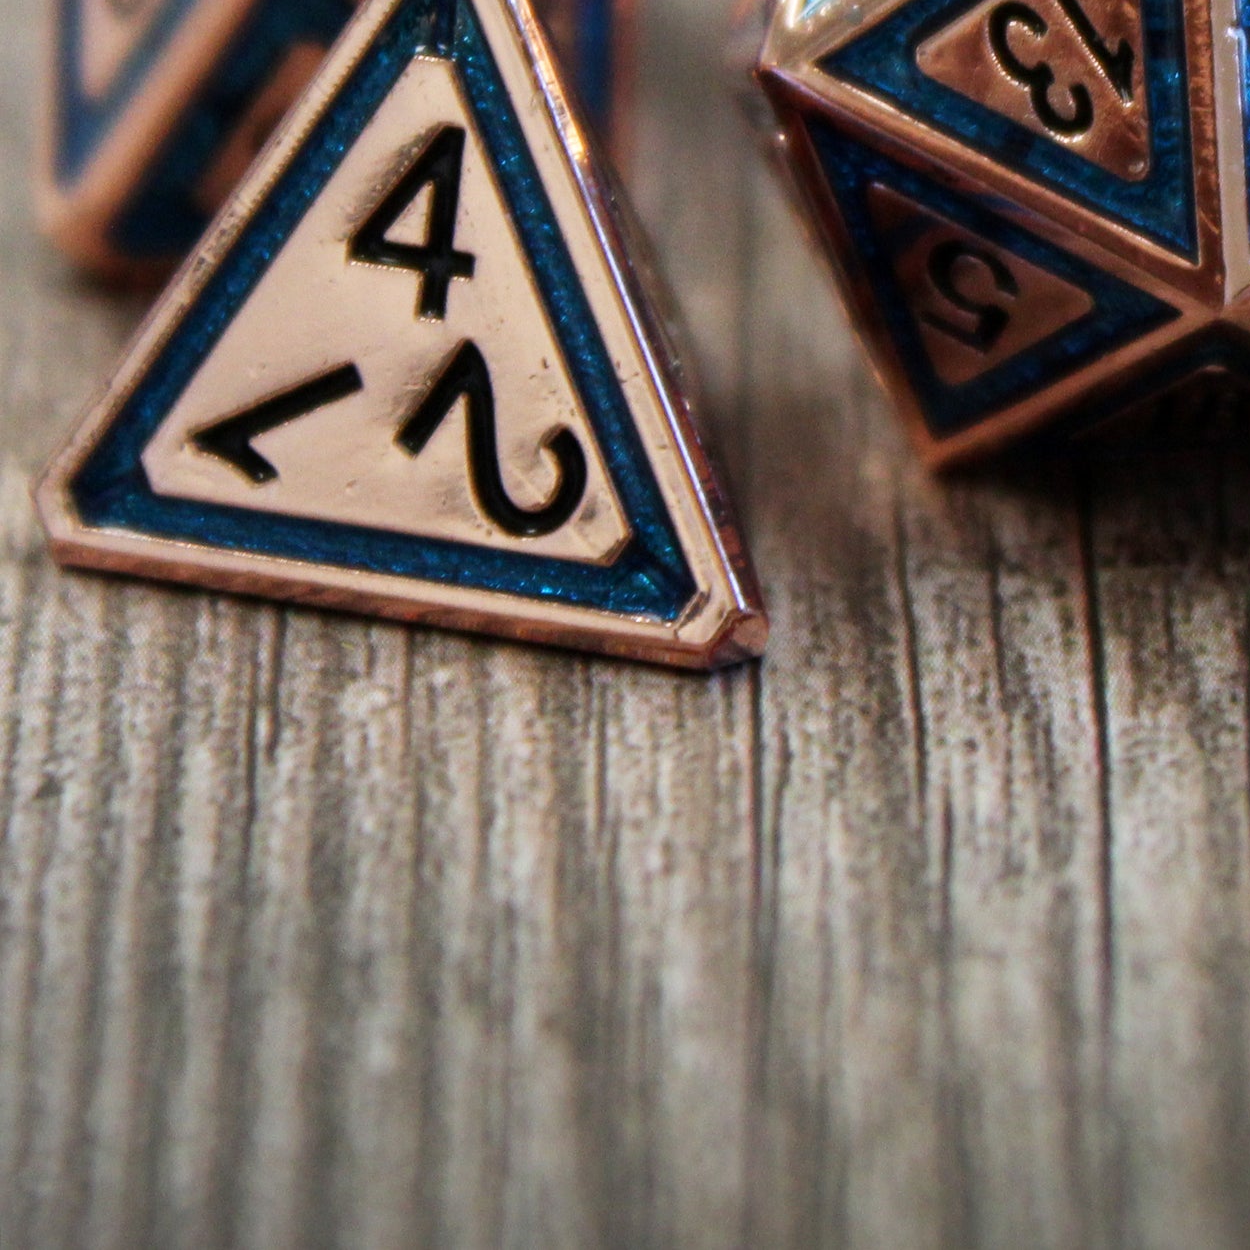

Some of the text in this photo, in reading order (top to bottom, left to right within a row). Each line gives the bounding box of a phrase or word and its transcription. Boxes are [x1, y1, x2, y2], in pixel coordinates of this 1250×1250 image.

[347, 124, 475, 322] 4
[922, 240, 1019, 352] 5
[191, 363, 364, 484] 1
[396, 338, 588, 537] 2
